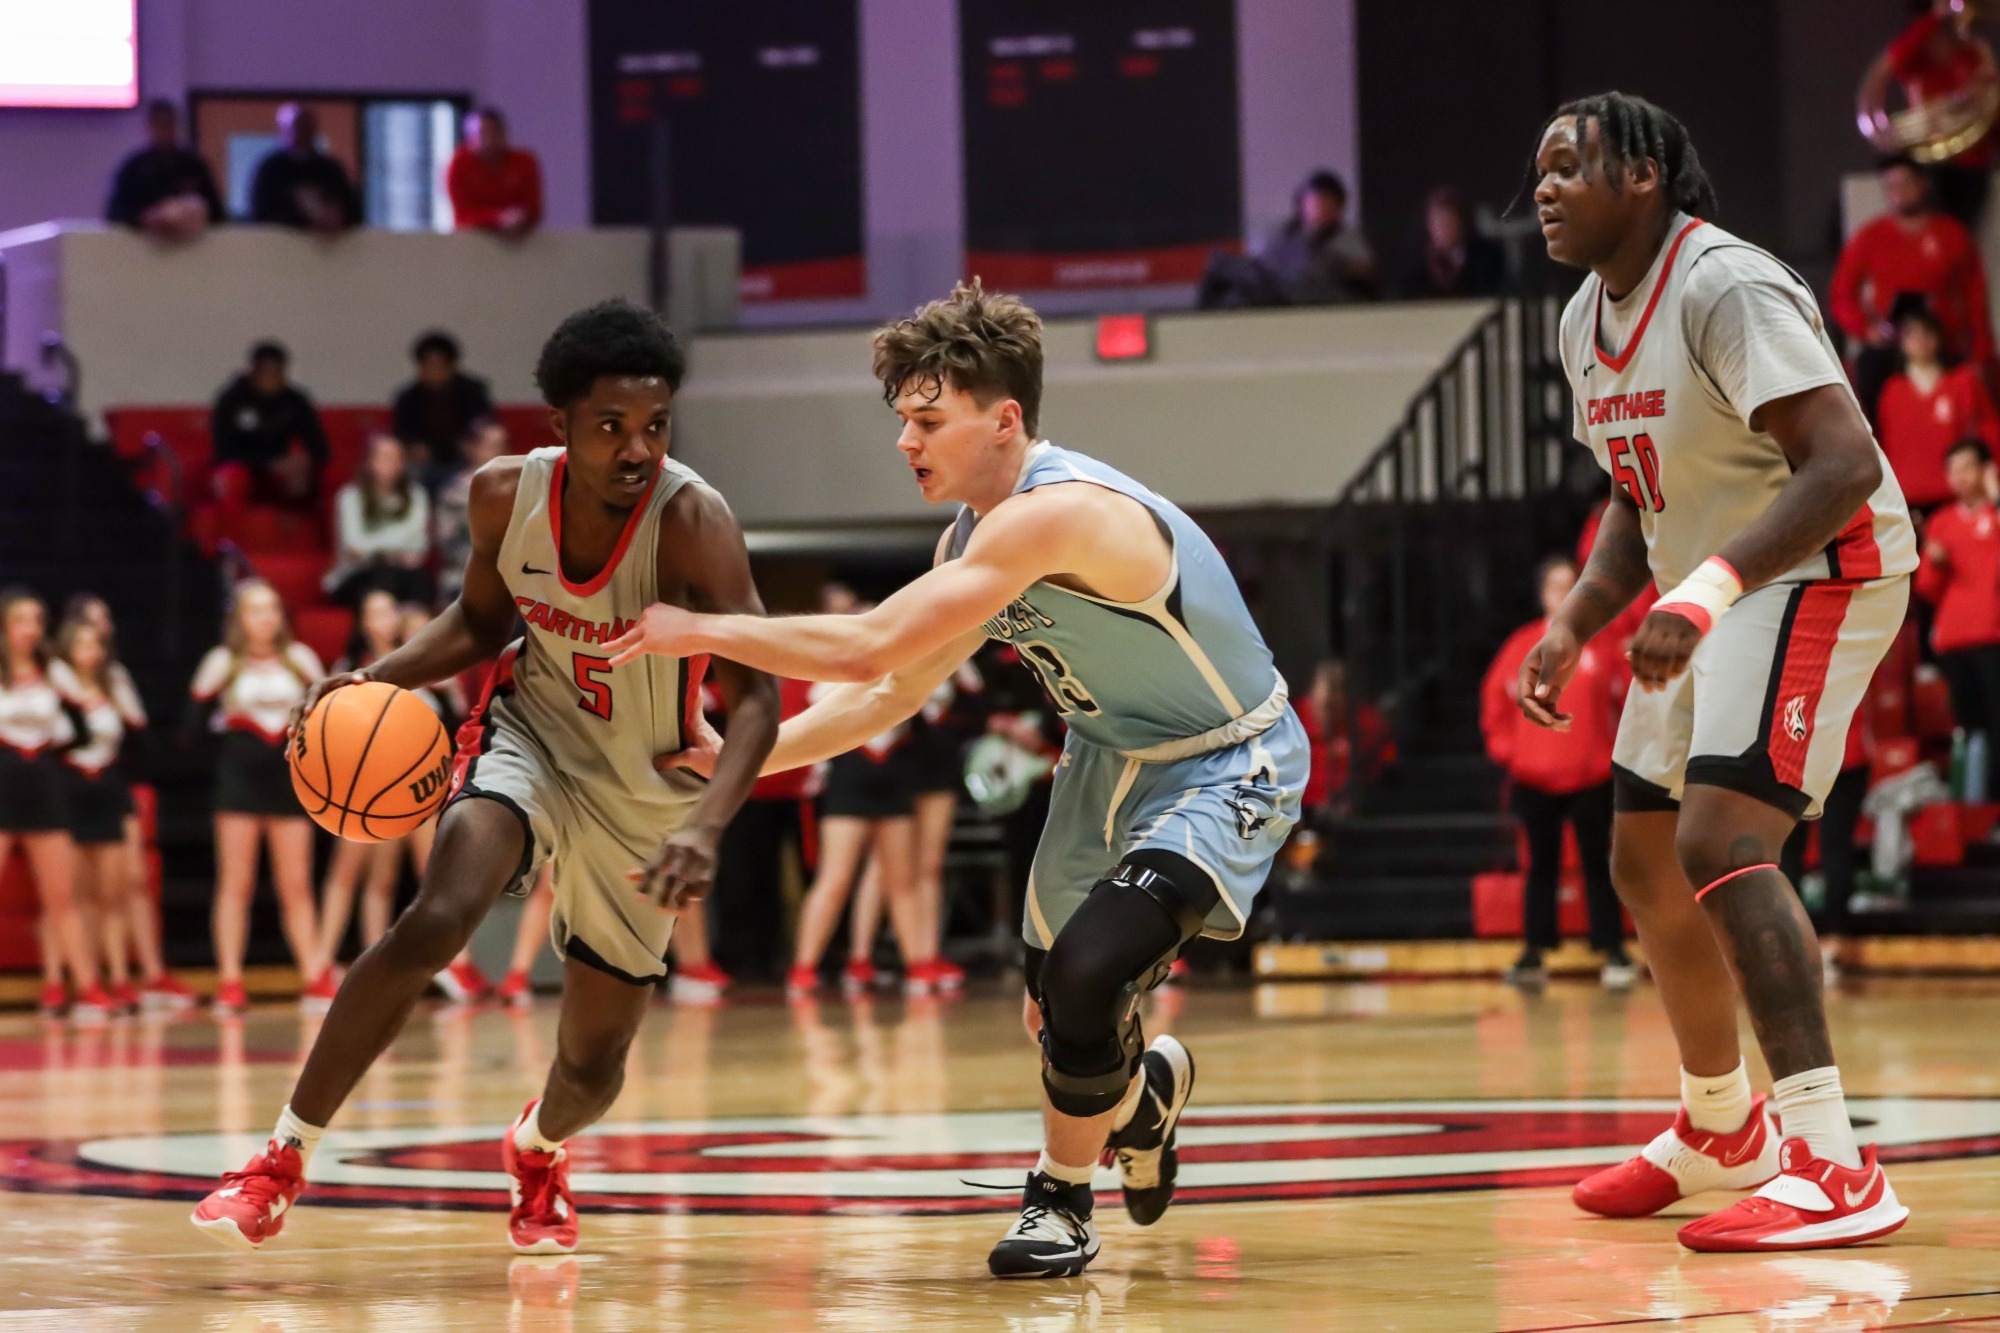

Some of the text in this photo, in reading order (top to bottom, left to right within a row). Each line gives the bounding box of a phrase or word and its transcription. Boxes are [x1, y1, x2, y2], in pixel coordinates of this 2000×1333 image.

[1587, 389, 1666, 426] CARTHAGE
[1606, 432, 1665, 513] 50
[514, 595, 638, 645] CARTHA
[572, 651, 613, 722] 5
[408, 755, 453, 804] Wil
